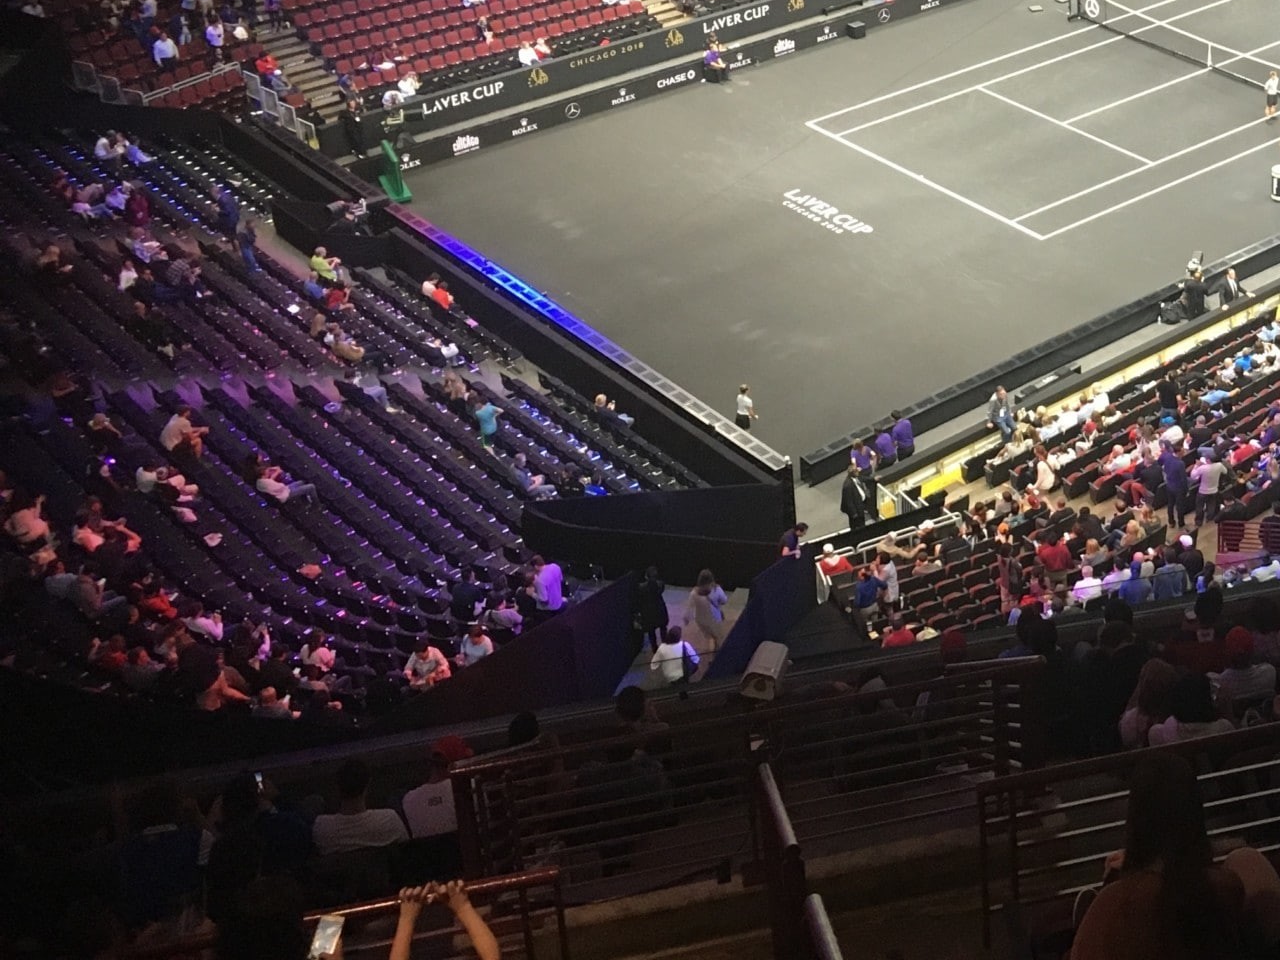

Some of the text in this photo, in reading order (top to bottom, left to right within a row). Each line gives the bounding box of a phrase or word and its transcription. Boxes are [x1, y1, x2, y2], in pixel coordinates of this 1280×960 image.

[921, 0, 940, 11] ROLEX
[703, 4, 770, 34] LAVER CUP
[817, 31, 838, 43] ROLEX
[569, 41, 645, 69] CHICAGO 2018
[729, 58, 752, 70] ROLEX
[656, 72, 688, 89] CHASE
[422, 80, 505, 115] LAVER CUP
[611, 92, 636, 106] ROLEX
[511, 122, 538, 136] ROLEX
[400, 158, 421, 171] OLEX
[782, 200, 822, 222] CHICAGO
[783, 189, 874, 234] LAVER CUP
